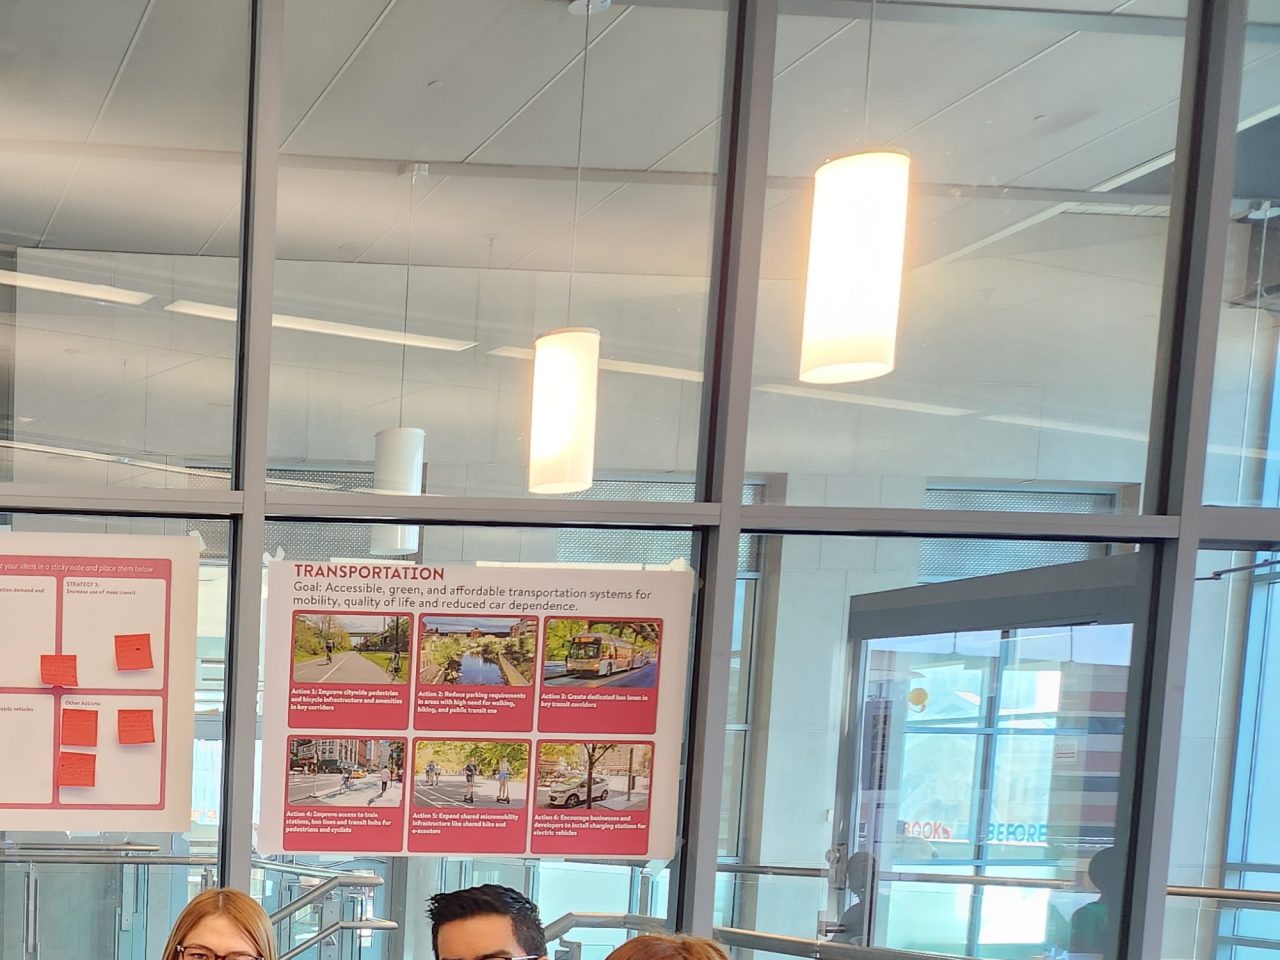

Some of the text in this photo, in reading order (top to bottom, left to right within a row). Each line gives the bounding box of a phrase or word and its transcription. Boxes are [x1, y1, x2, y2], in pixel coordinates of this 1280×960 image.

[50, 564, 69, 572] sticky
[99, 565, 117, 573] place
[295, 564, 444, 581] TRANSPORTATION
[294, 582, 652, 602] Goal: Accessible, green, and affordable transportation systems for
[293, 595, 578, 612] mobility, quality of life and reduced car dependence.
[492, 700, 516, 708] walking,
[987, 823, 1048, 843] BEFORE
